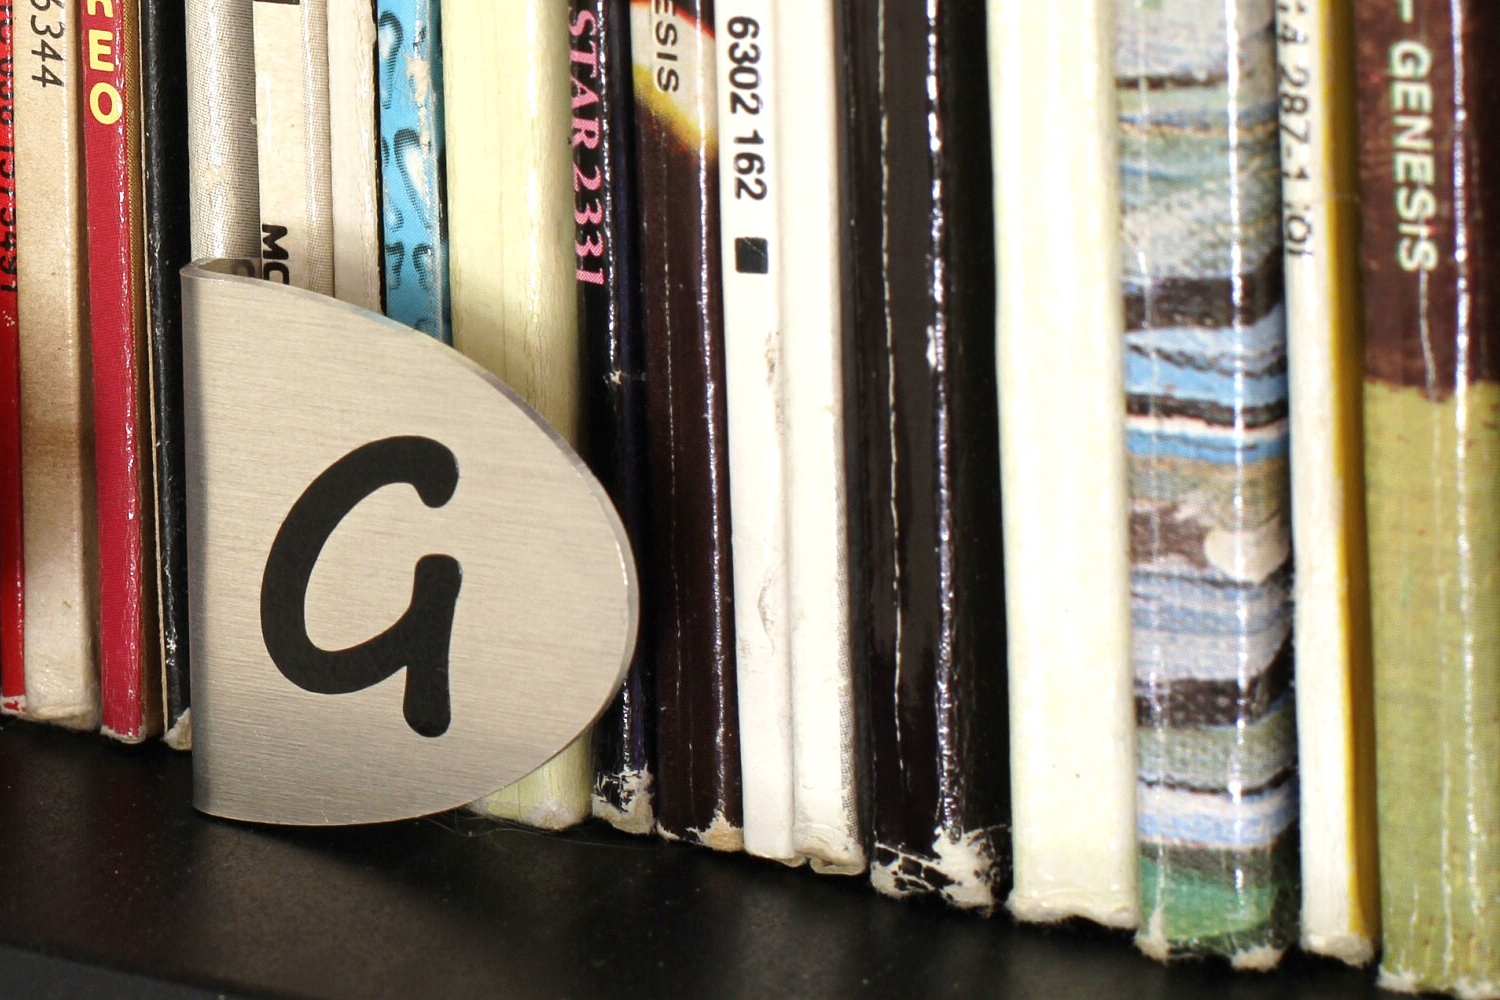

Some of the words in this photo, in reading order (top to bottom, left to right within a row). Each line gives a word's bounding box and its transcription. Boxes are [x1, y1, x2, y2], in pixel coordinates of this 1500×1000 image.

[567, 6, 601, 150] STAR
[727, 16, 763, 115] 6302
[732, 129, 767, 201] 162
[1388, 40, 1438, 272] GENESIS
[572, 161, 605, 286] 2331
[259, 434, 464, 738] G
